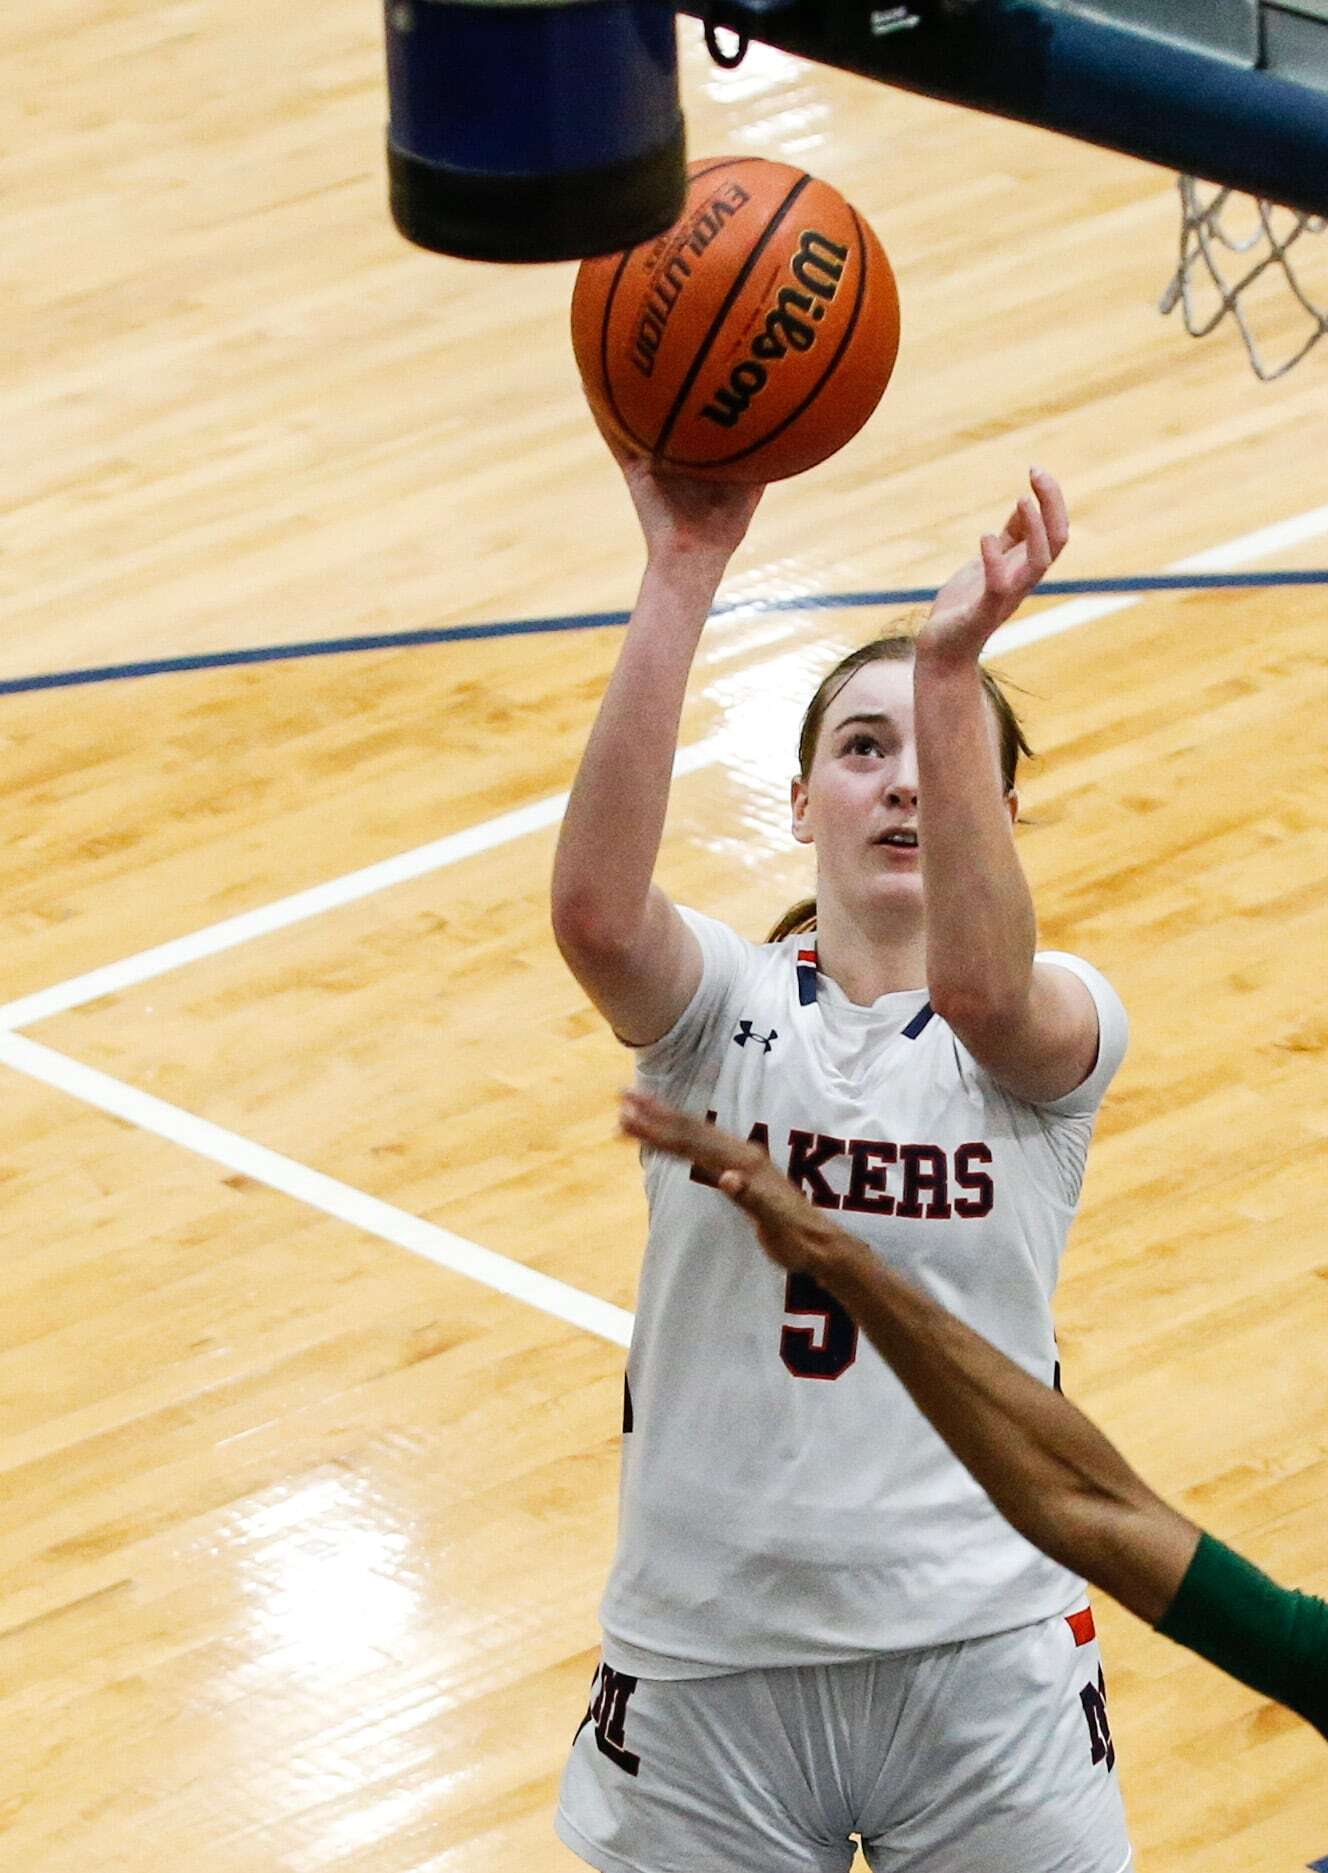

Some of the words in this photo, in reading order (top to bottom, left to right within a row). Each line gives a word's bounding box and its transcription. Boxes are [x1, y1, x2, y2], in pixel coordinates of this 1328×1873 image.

[630, 183, 751, 379] EVOLUTION
[700, 228, 851, 429] Wilson
[779, 1270, 860, 1381] 5
